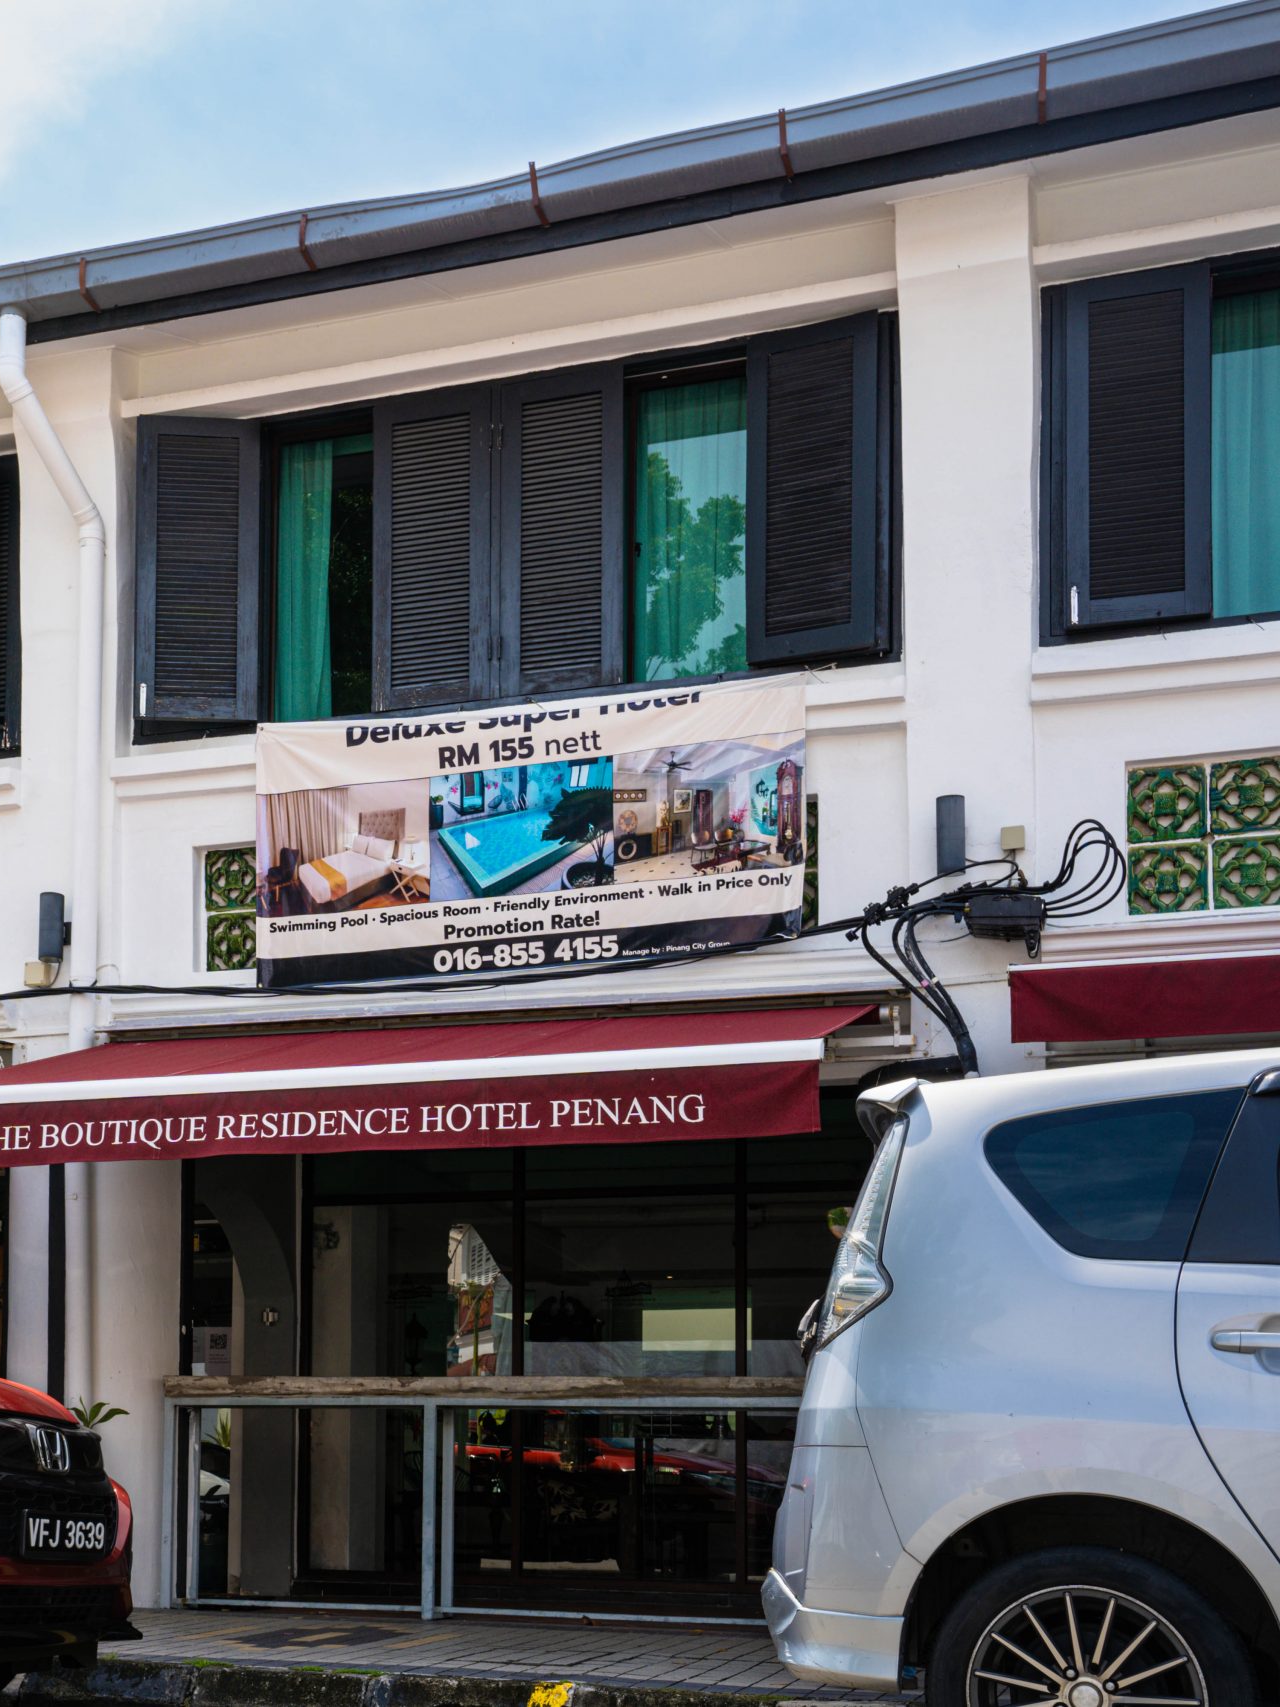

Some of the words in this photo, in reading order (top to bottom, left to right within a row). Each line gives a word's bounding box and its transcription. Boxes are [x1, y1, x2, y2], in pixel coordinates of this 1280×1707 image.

[438, 746, 481, 769] RM
[488, 736, 535, 762] 155
[544, 730, 602, 756] nett
[269, 919, 337, 934] Swimming
[340, 914, 369, 928] Pool
[379, 908, 439, 926] Spacious
[442, 904, 482, 918] Room
[492, 897, 550, 913] Friendly
[554, 889, 645, 907] Environment
[657, 882, 693, 898] Walk
[698, 880, 712, 893] in
[715, 875, 754, 891] Price
[758, 872, 793, 887] Only
[443, 918, 544, 940] Promotion
[550, 911, 601, 931] Rate!
[432, 941, 545, 973] 016-855
[553, 935, 619, 962] 4155
[622, 948, 650, 957] Manage
[651, 946, 661, 954] by
[666, 944, 691, 953] Pinang
[691, 942, 707, 951] City
[37, 1115, 208, 1150] BOUTIQUE
[214, 1106, 411, 1140] RESIDENCE
[419, 1102, 541, 1133] HOTEL
[549, 1093, 707, 1128] PENANG
[28, 1517, 61, 1548] VFJ
[64, 1519, 105, 1550] 3639
